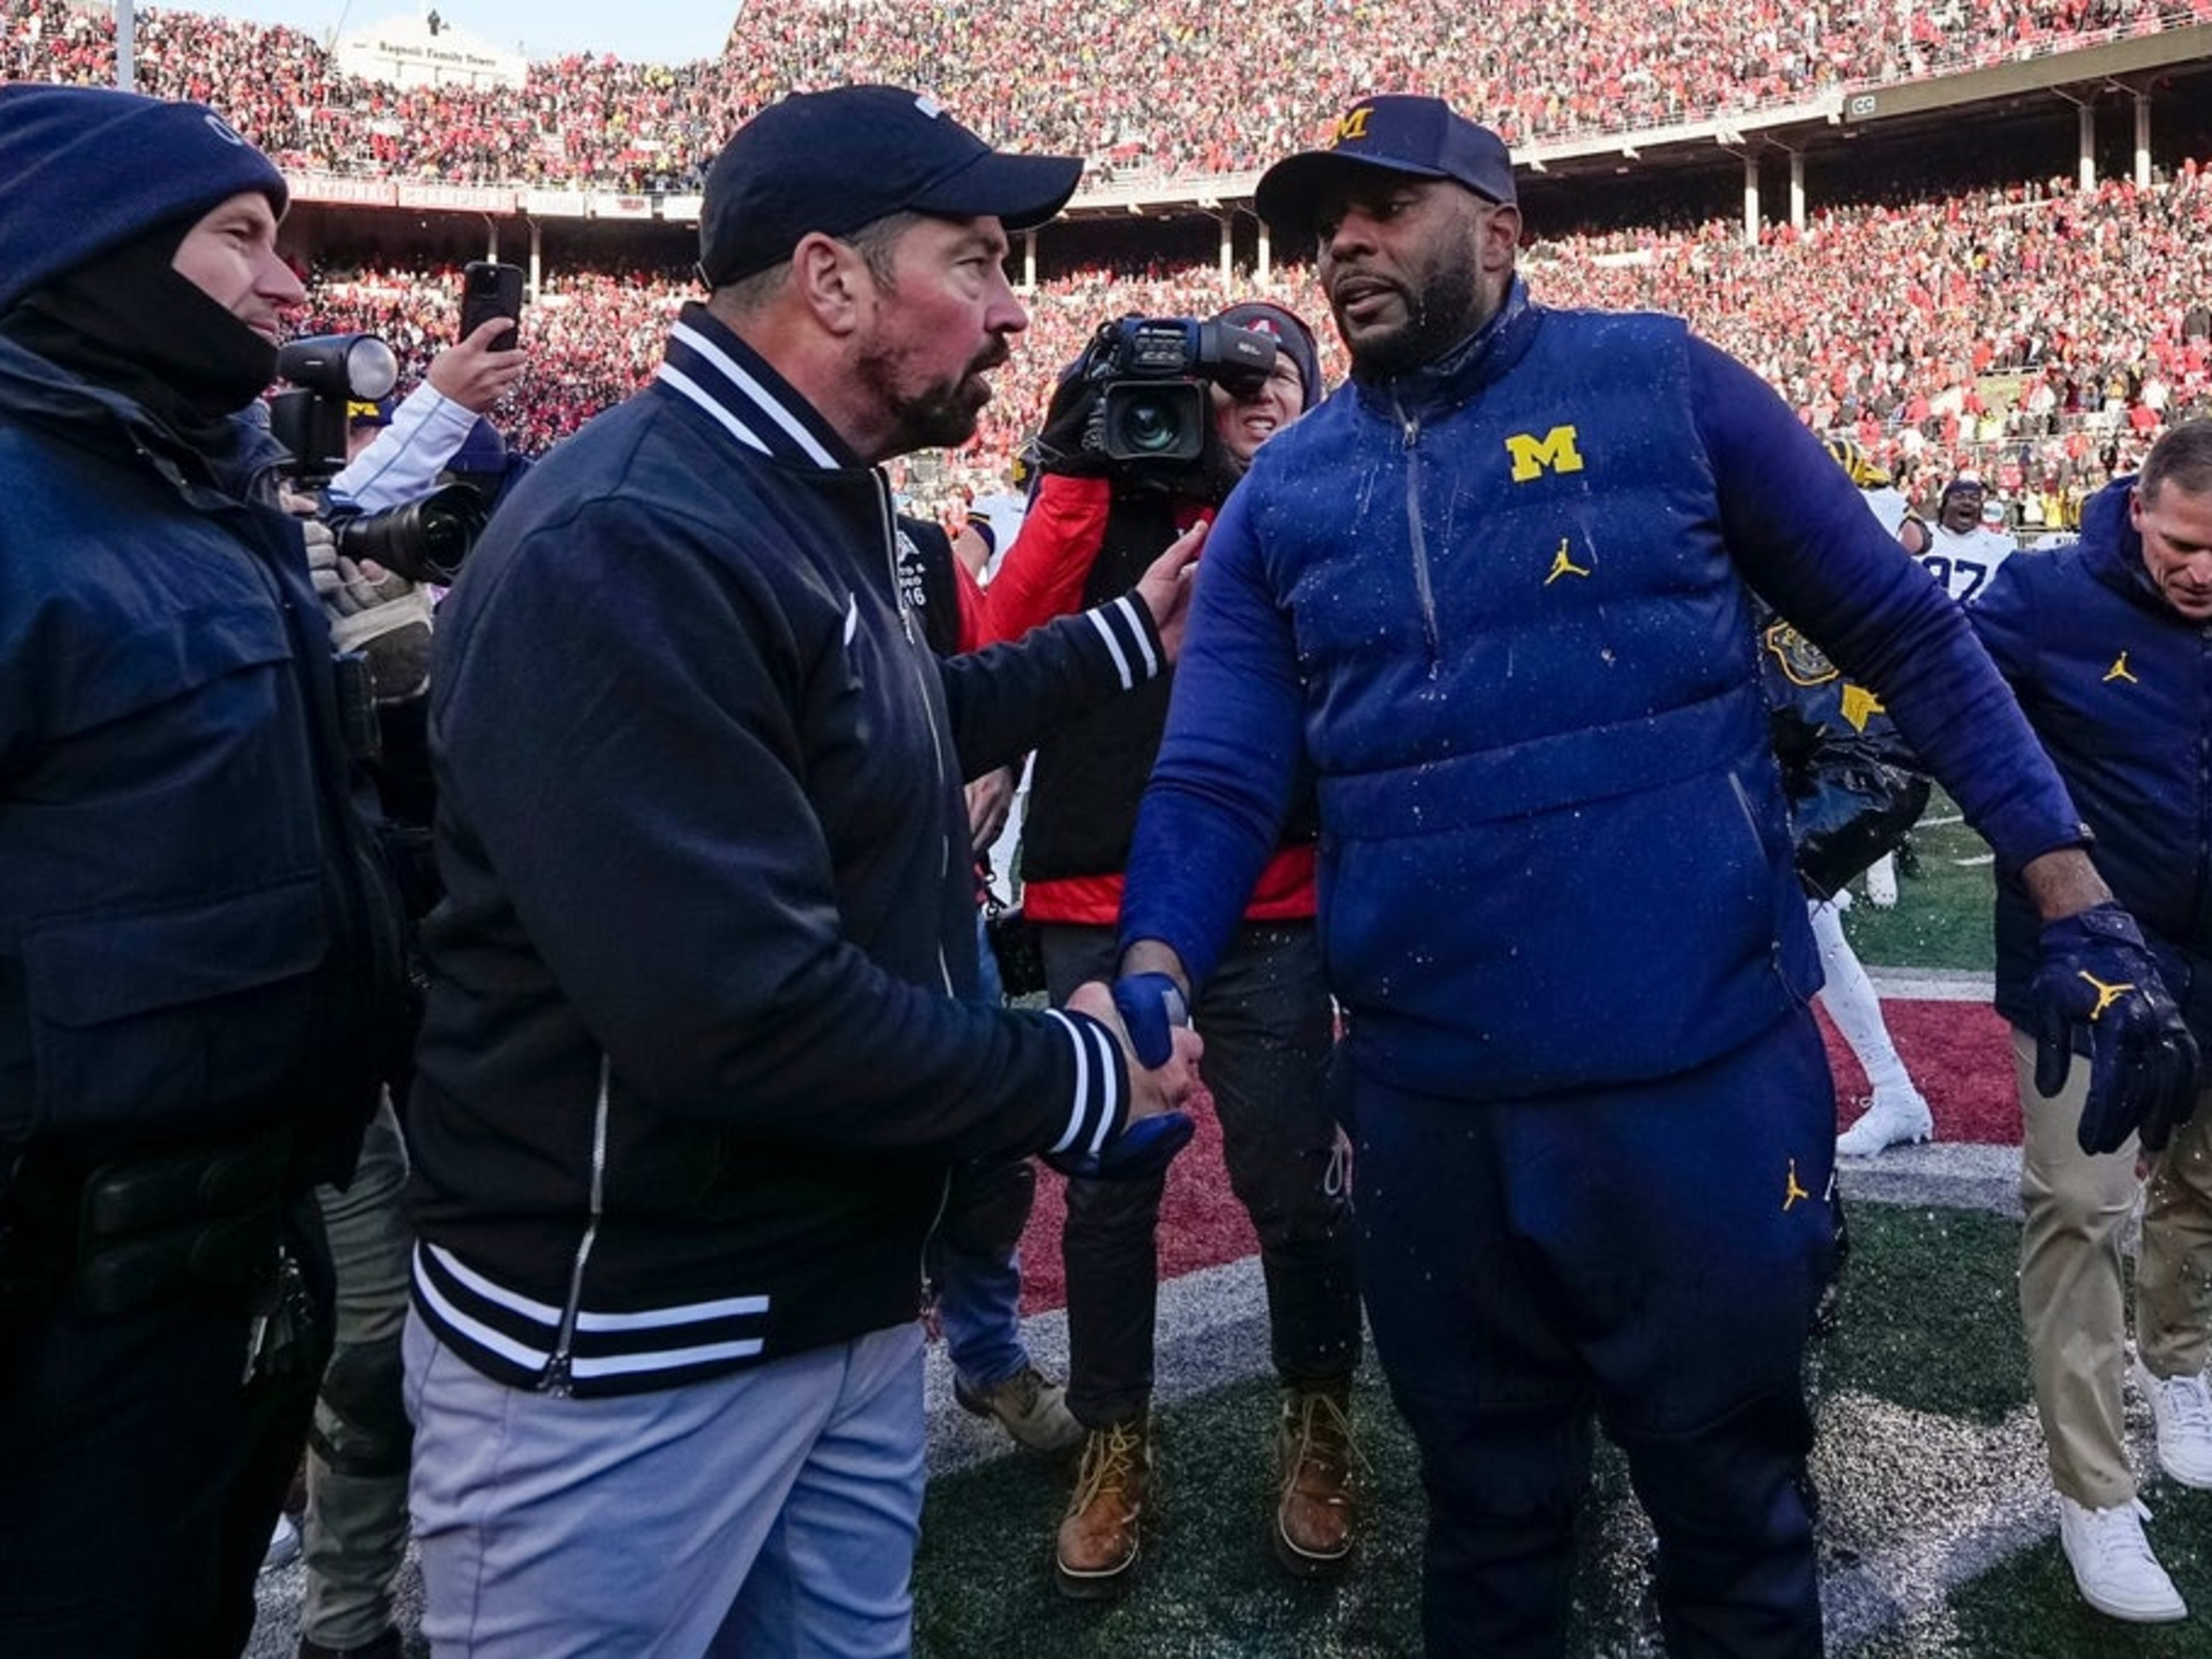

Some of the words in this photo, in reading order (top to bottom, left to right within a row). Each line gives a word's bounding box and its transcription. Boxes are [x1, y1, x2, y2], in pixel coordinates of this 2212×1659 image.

[427, 48, 463, 63] Family
[1854, 99, 1873, 112] CC
[1327, 108, 1374, 150] M
[347, 400, 380, 418] M
[1505, 425, 1584, 482] M
